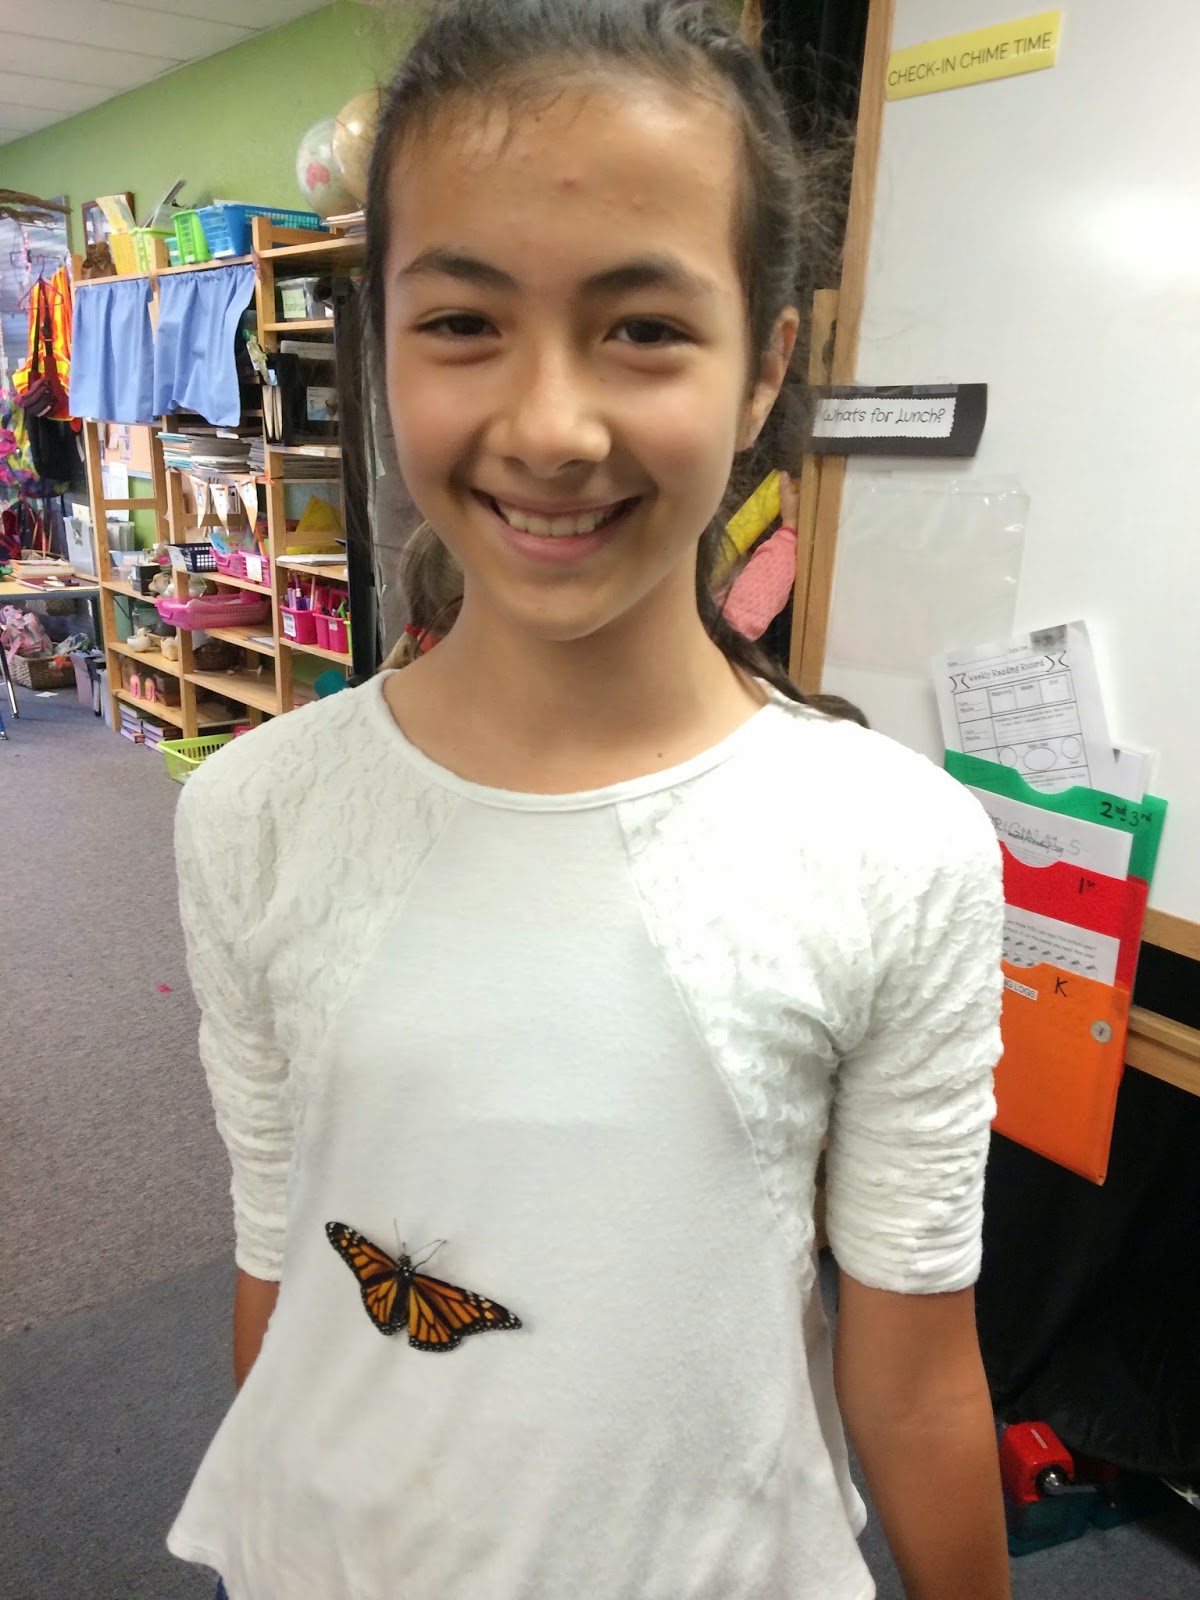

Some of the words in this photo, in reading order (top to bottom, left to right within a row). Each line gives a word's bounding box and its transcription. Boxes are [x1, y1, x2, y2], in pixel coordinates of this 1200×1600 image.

[888, 56, 956, 86] CHECK-IN
[960, 42, 1009, 69] CHIME
[1014, 31, 1052, 56] TIME
[871, 407, 894, 423] for
[895, 407, 946, 424] Lunch?
[991, 665, 1020, 677] Reading
[1021, 659, 1045, 671] Record
[1014, 983, 1036, 999] LOGS
[1055, 977, 1068, 997] K
